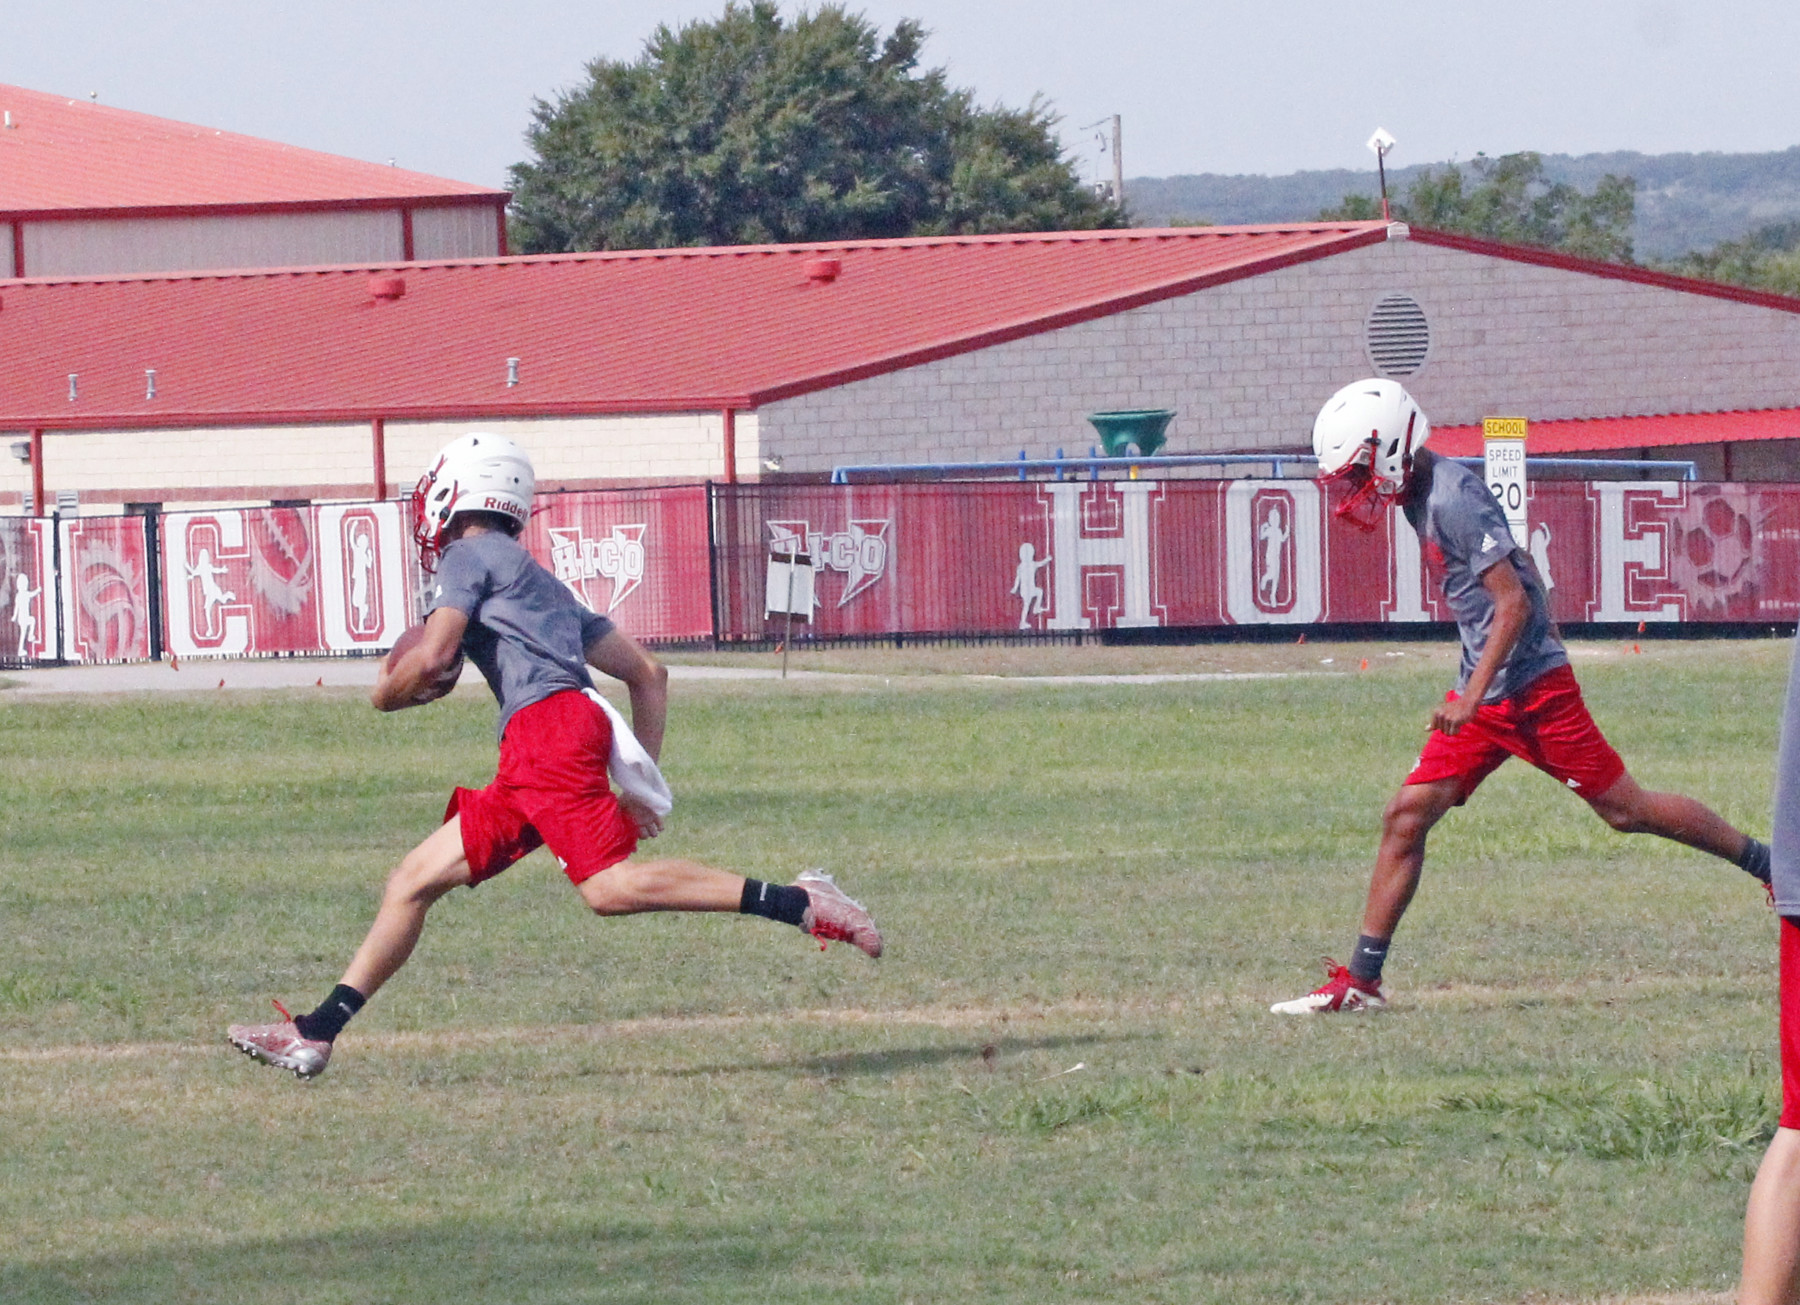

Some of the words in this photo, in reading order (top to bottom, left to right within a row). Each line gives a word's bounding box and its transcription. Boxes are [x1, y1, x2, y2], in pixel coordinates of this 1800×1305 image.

[1485, 421, 1524, 435] SCHOOL
[1489, 449, 1521, 462] SPEED
[1492, 466, 1518, 478] LIMIT
[1042, 480, 1683, 629] HOE
